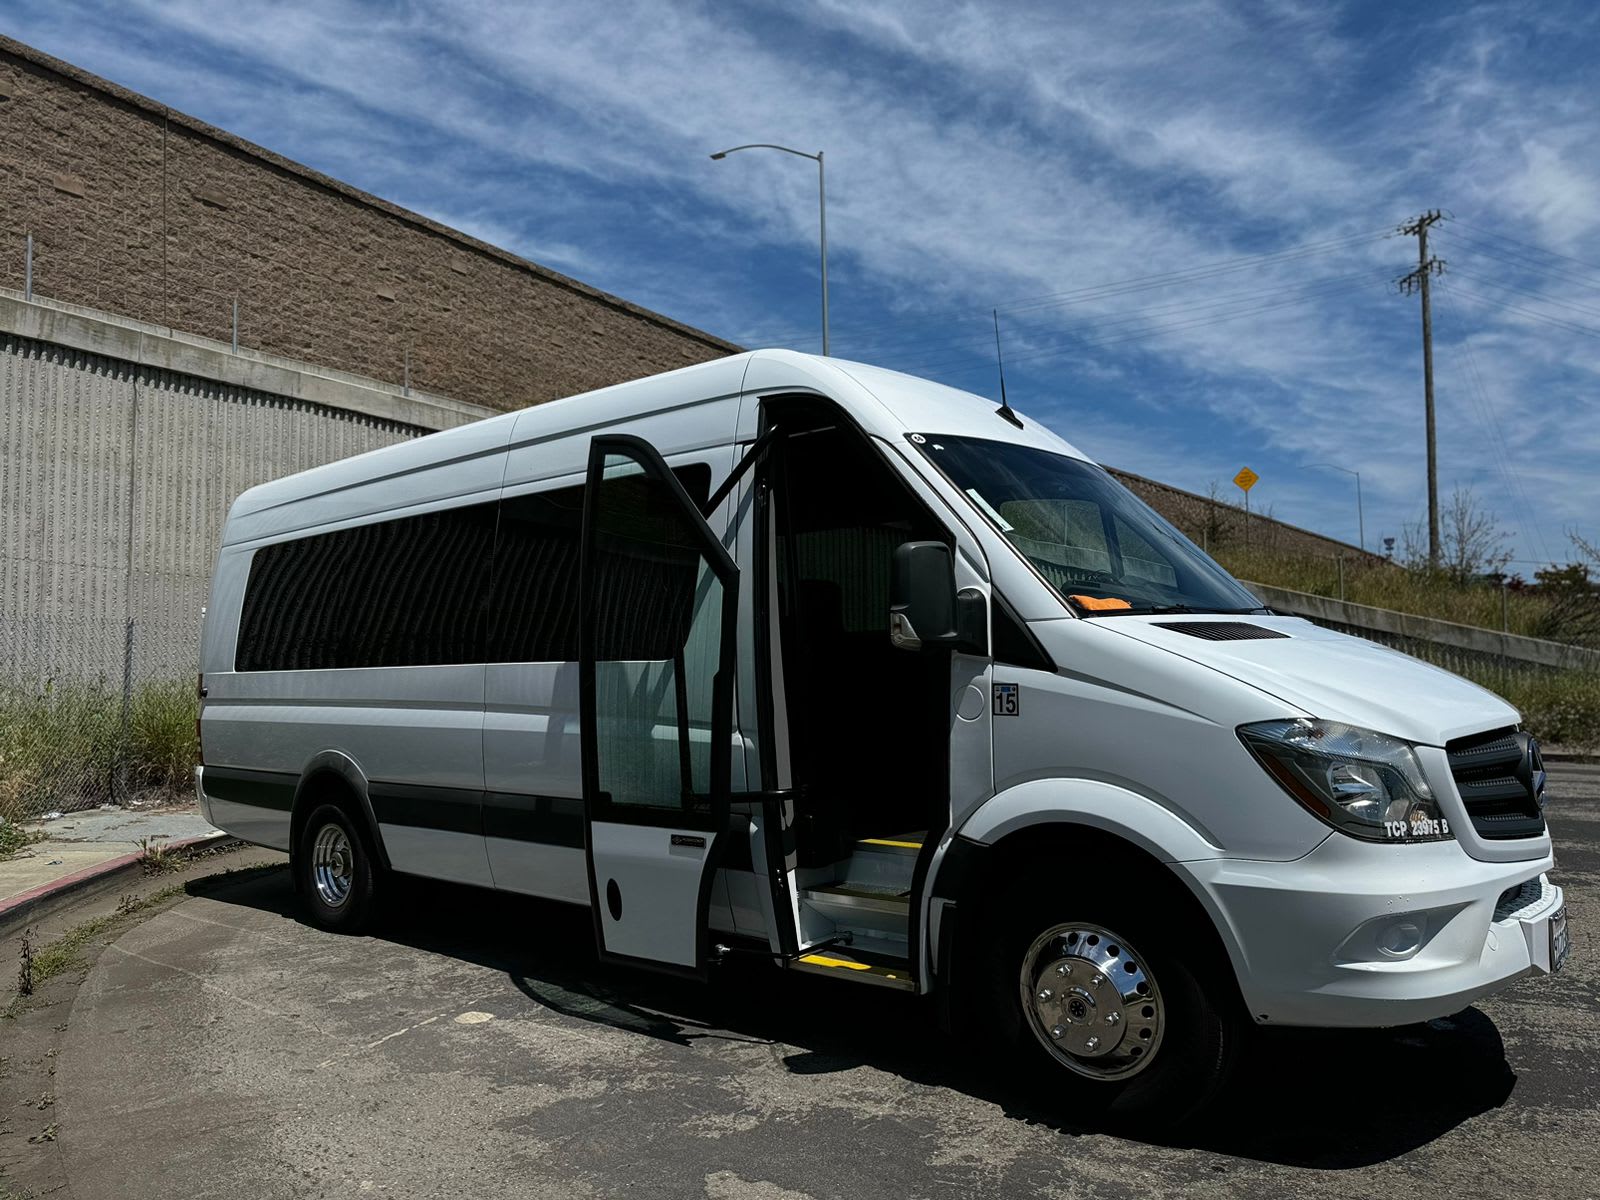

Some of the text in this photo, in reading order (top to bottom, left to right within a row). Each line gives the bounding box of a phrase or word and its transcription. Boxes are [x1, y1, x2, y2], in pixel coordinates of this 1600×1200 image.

[995, 692, 1016, 714] 15
[1384, 818, 1449, 837] TCP 23975 B
